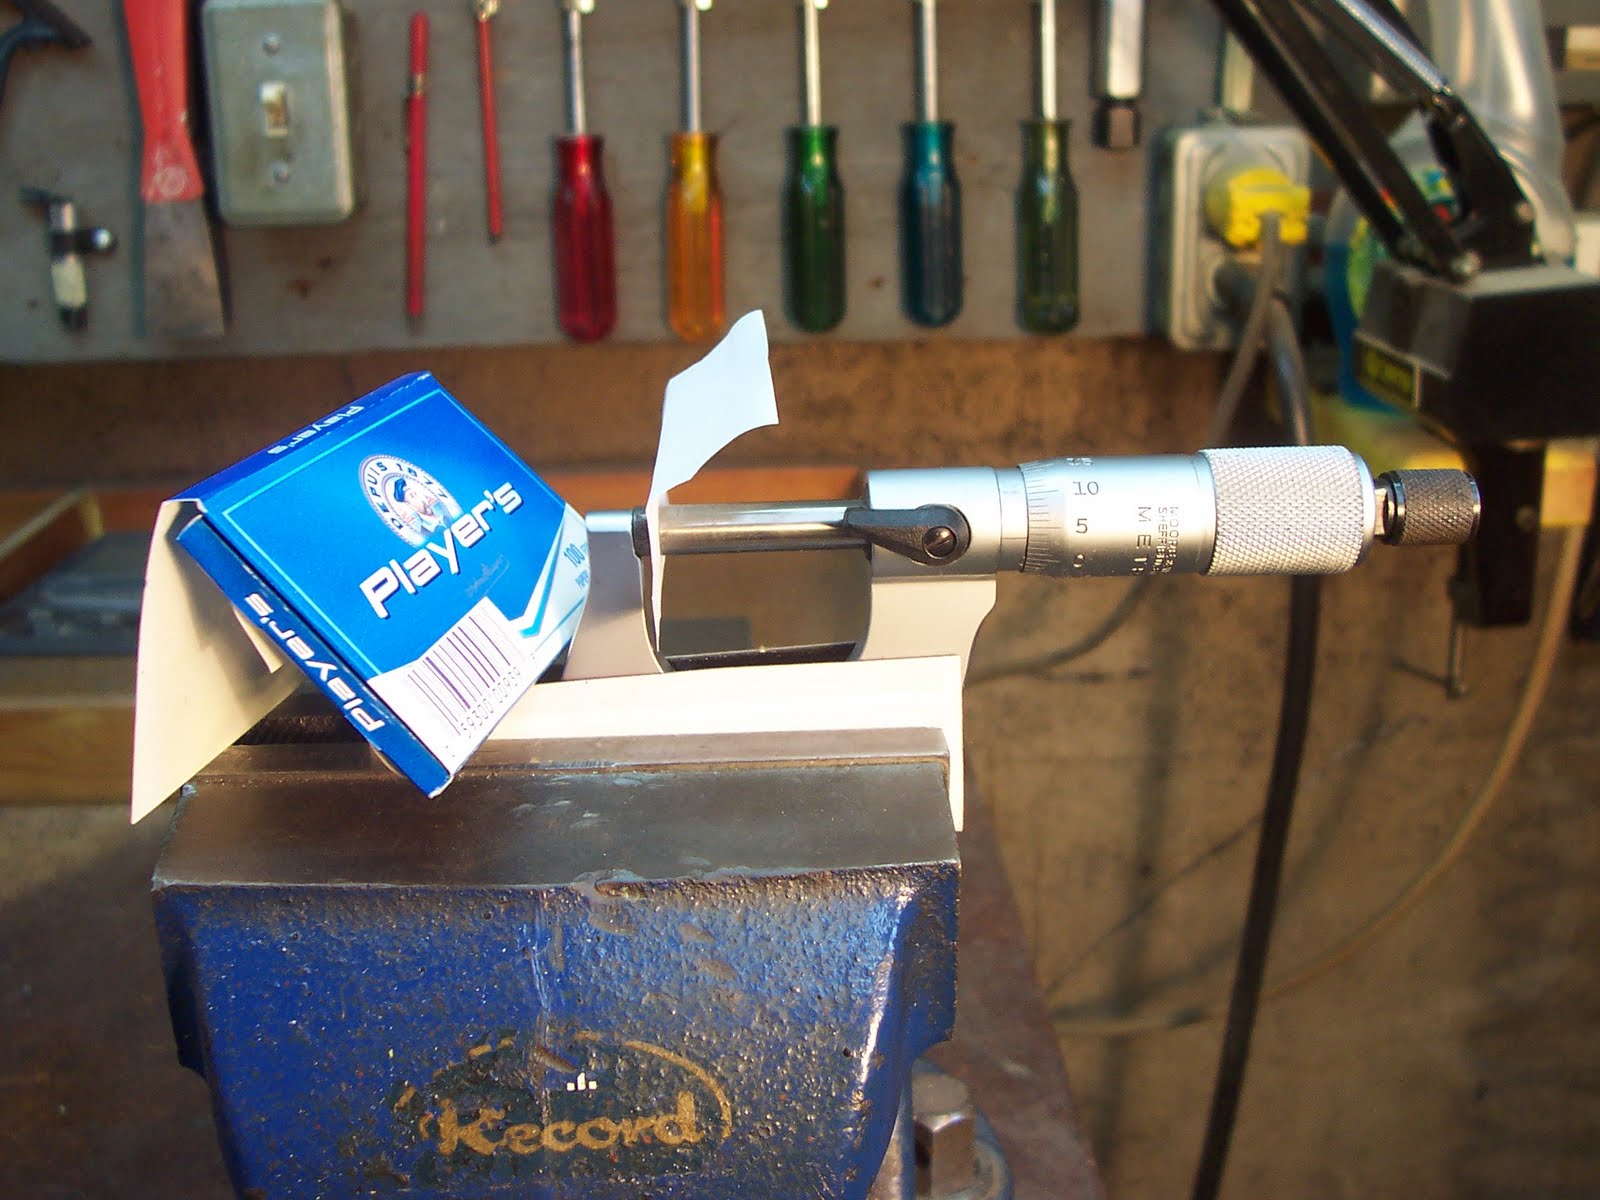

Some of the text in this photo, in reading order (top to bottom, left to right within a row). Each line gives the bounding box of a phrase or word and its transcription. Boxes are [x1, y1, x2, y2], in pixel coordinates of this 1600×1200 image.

[267, 405, 365, 454] Player's
[367, 461, 404, 530] DEPUIS
[1072, 481, 1099, 496] 10
[1076, 518, 1088, 533] 5
[359, 482, 523, 619] Player's
[563, 543, 586, 567] 100
[244, 593, 386, 732] Player's
